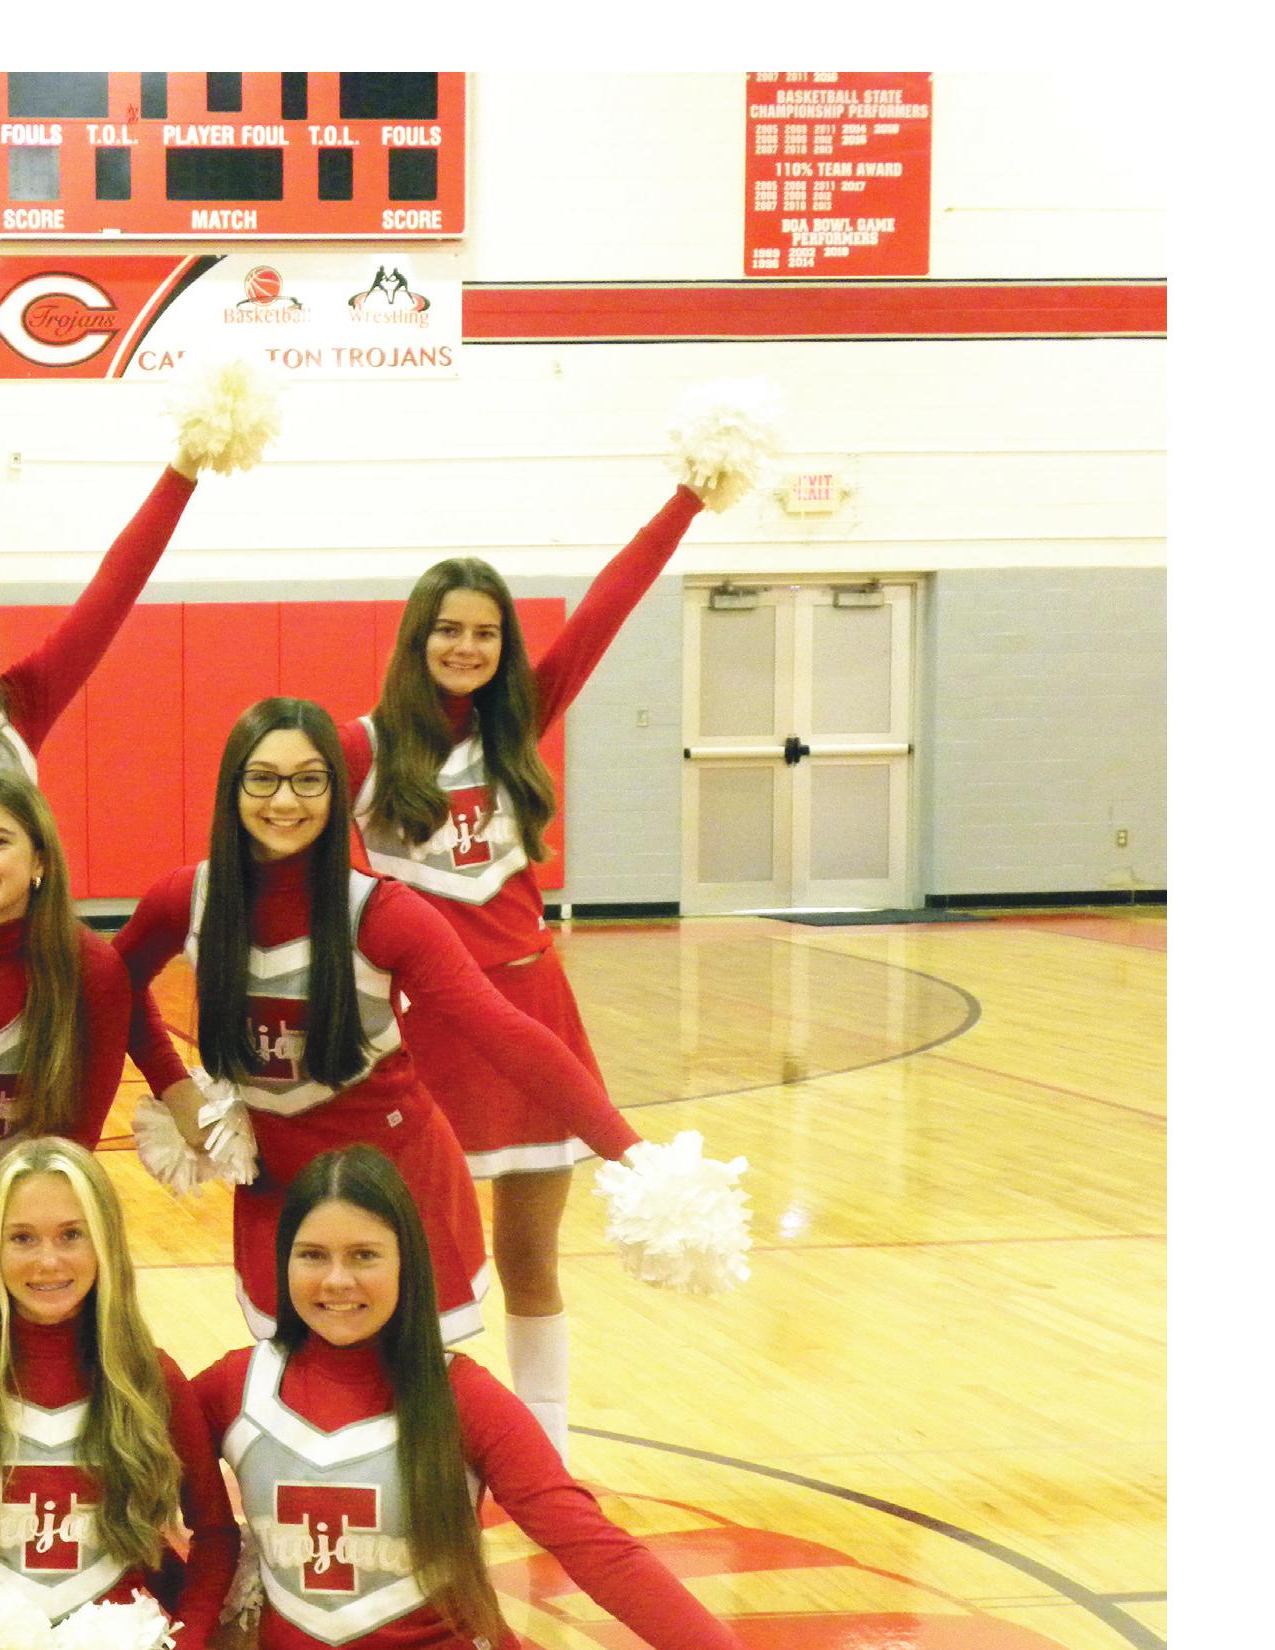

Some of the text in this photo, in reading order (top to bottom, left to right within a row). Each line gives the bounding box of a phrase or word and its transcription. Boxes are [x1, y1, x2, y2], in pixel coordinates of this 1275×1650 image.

[777, 90, 903, 104] BASKETBALL STATE
[750, 104, 928, 118] CHAMPIONSHIP PERFORMERS
[1, 124, 442, 145] FOULS T.O.L. PLAYER FOUL T.O.L. FOULS
[775, 163, 903, 177] 110% TEAM AWARD
[3, 209, 443, 230] SCORE MATCH SCORE
[857, 218, 895, 232] GAME
[792, 232, 878, 246] PERFORMERS
[29, 305, 116, 336] Trojans
[348, 308, 430, 328] Wrestling
[332, 346, 453, 368] TROJANS
